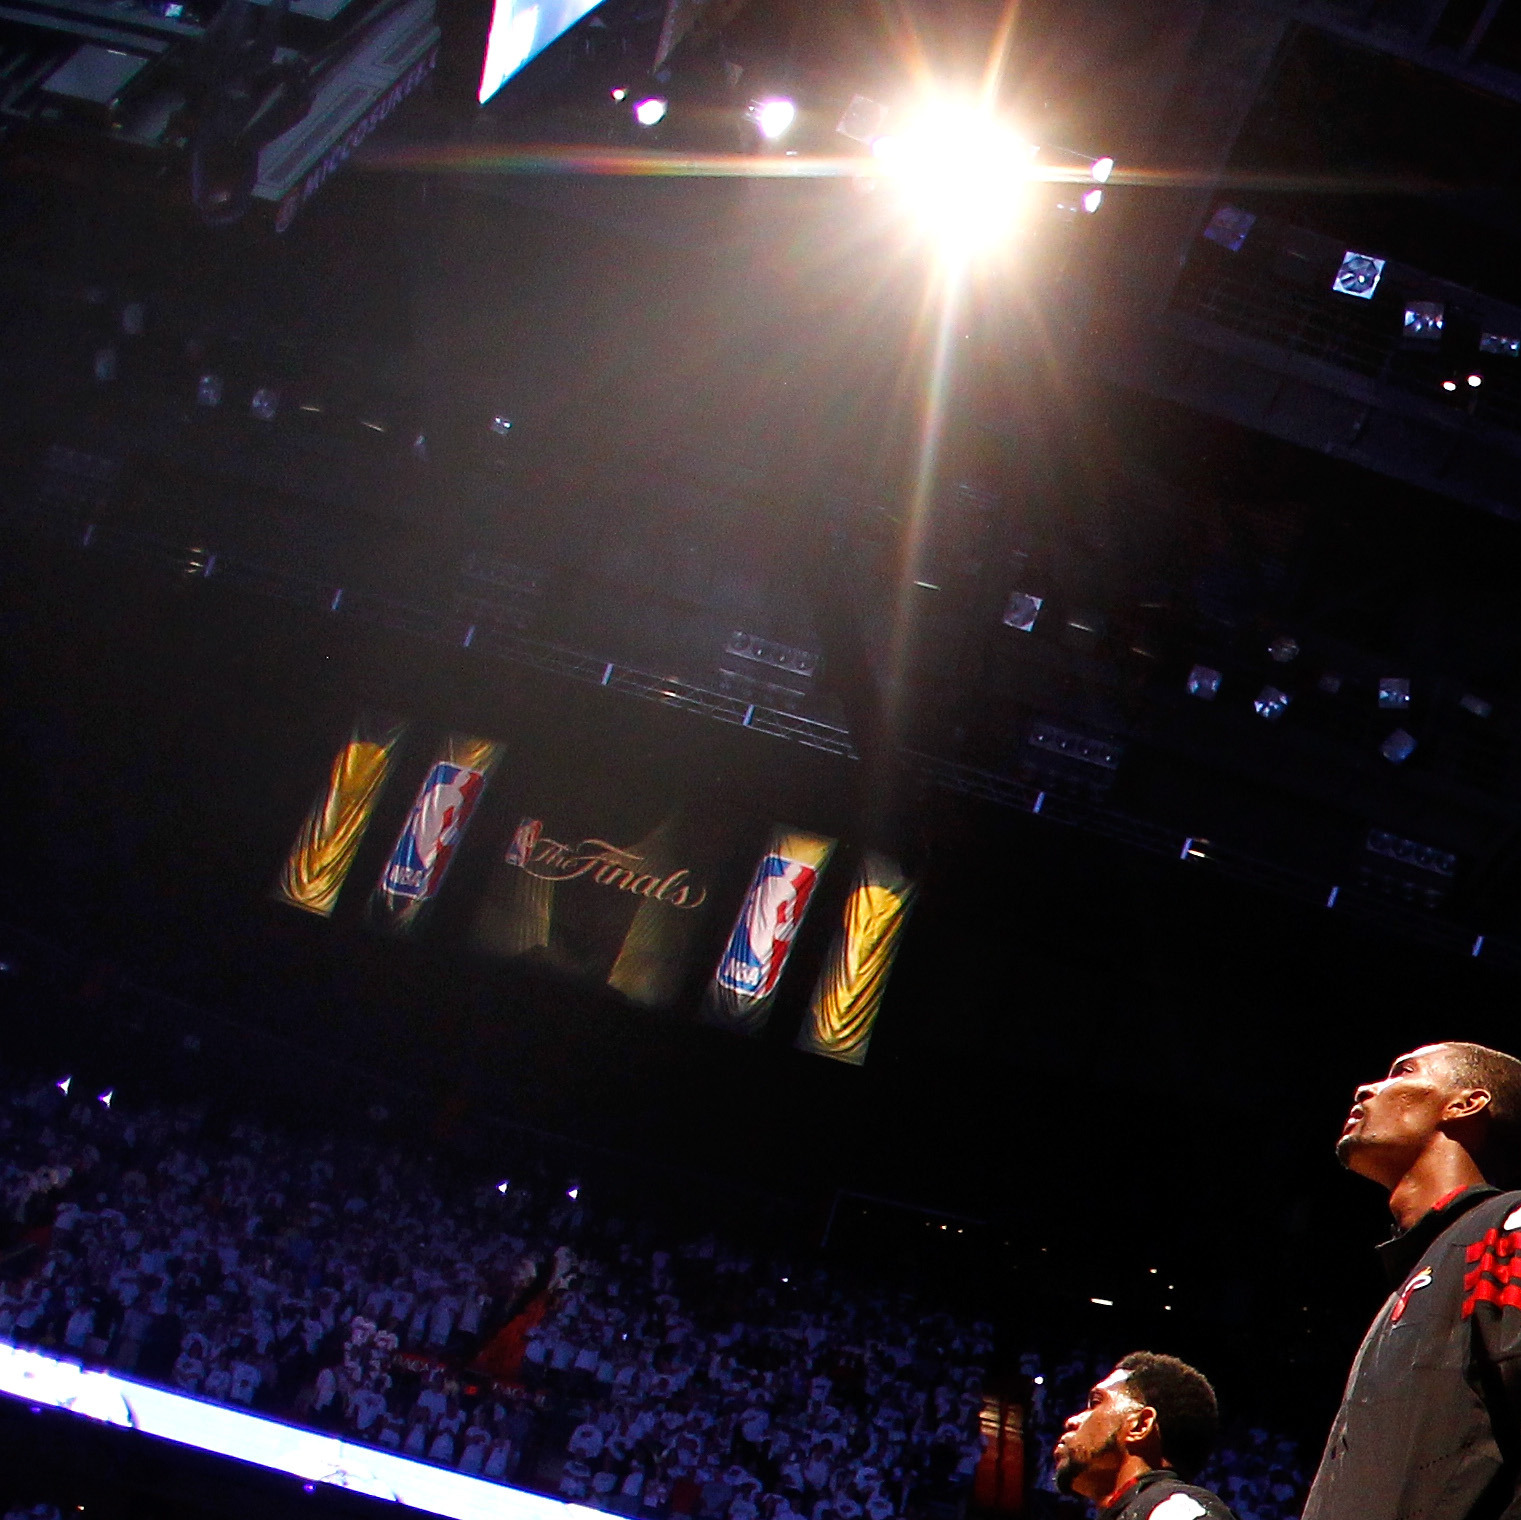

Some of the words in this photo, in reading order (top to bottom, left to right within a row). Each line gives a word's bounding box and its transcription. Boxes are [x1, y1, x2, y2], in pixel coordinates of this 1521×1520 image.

[530, 838, 577, 870] The
[524, 838, 706, 909] Finals
[724, 957, 760, 986] NBA
